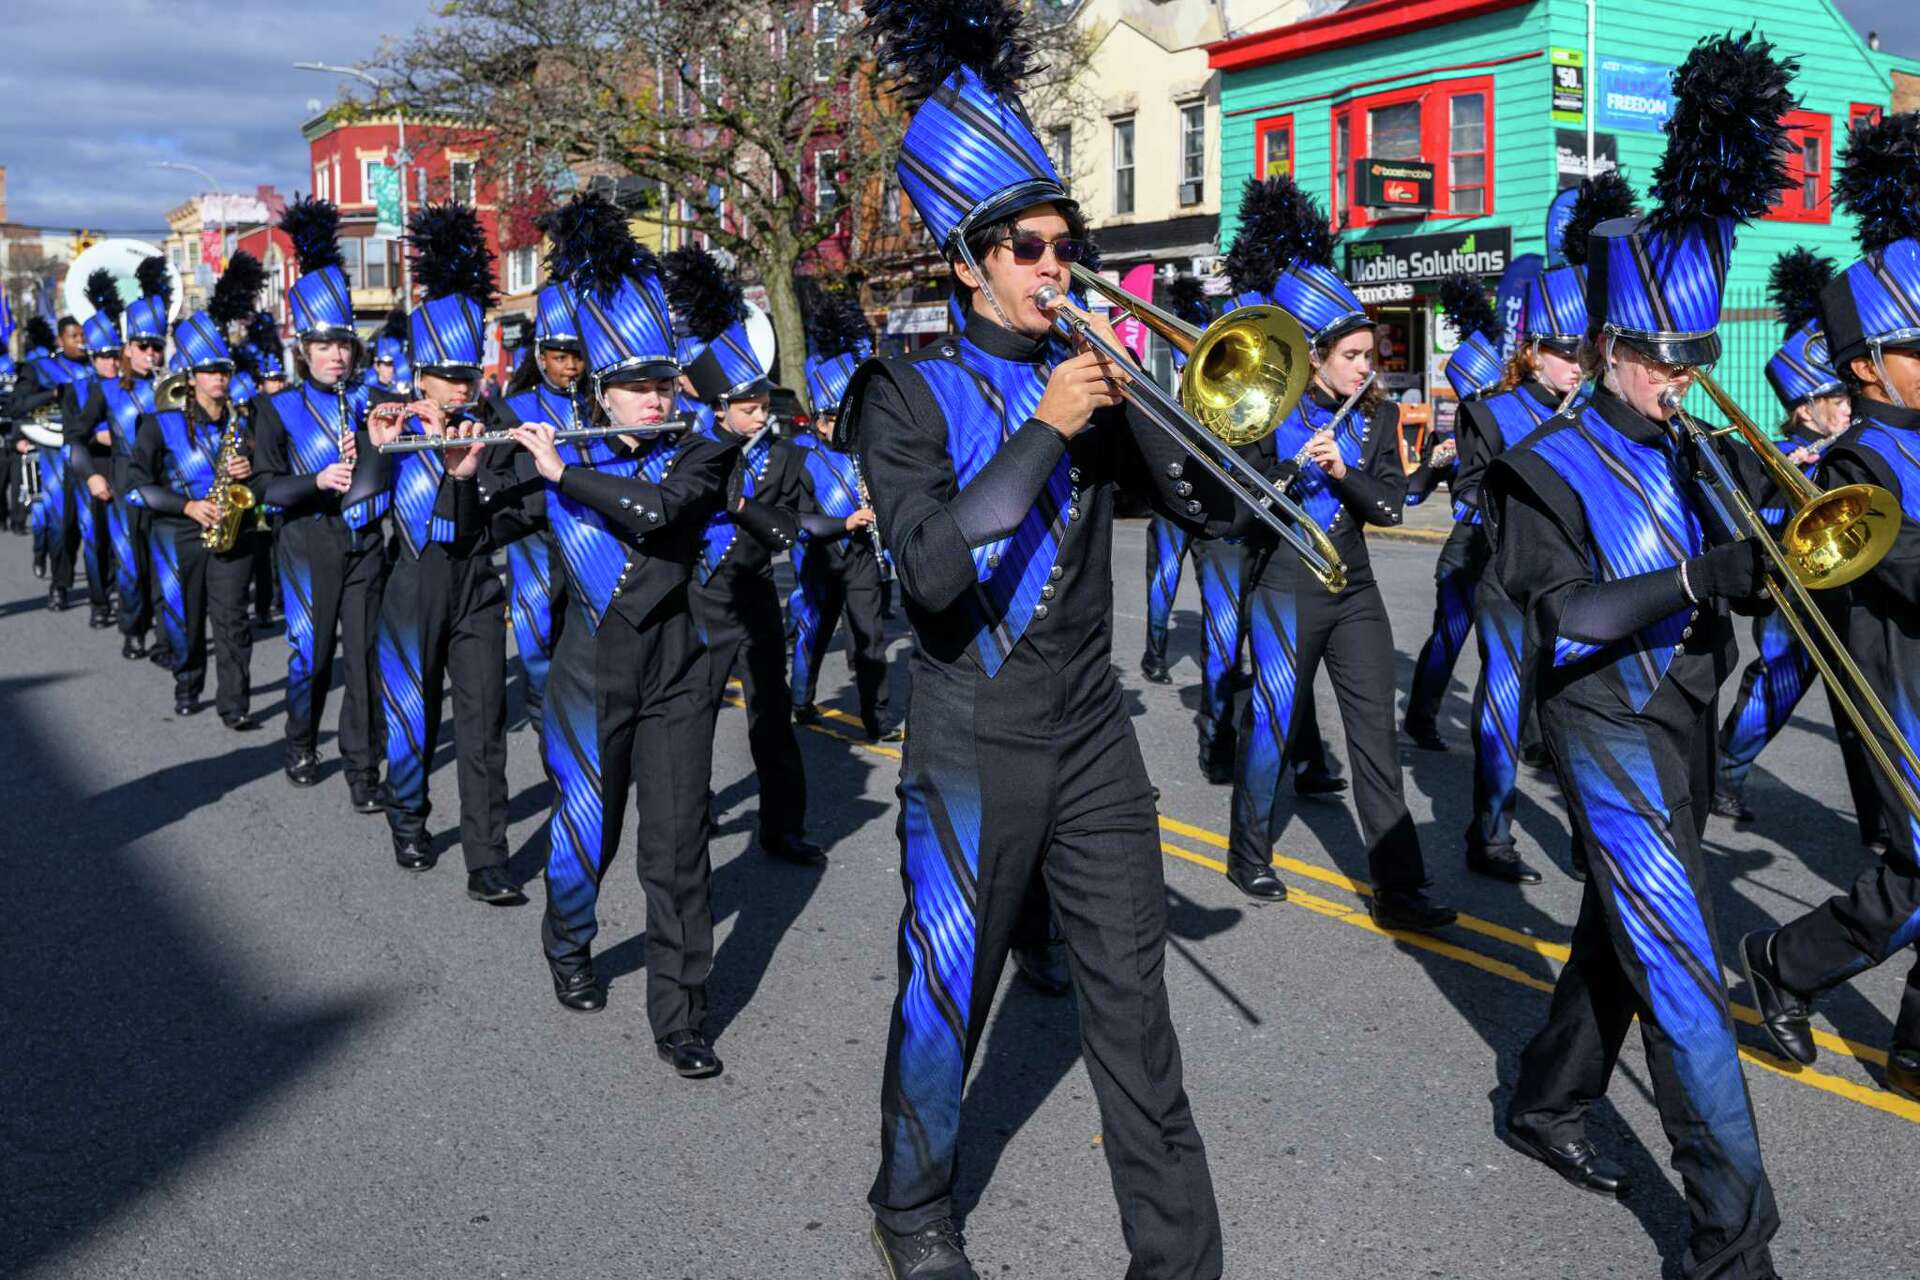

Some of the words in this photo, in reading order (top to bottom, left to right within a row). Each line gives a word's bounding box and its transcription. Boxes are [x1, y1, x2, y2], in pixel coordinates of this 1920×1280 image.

[1606, 92, 1667, 115] FREEDOM
[1351, 255, 1409, 283] Mobile
[1410, 249, 1505, 277] Solutions
